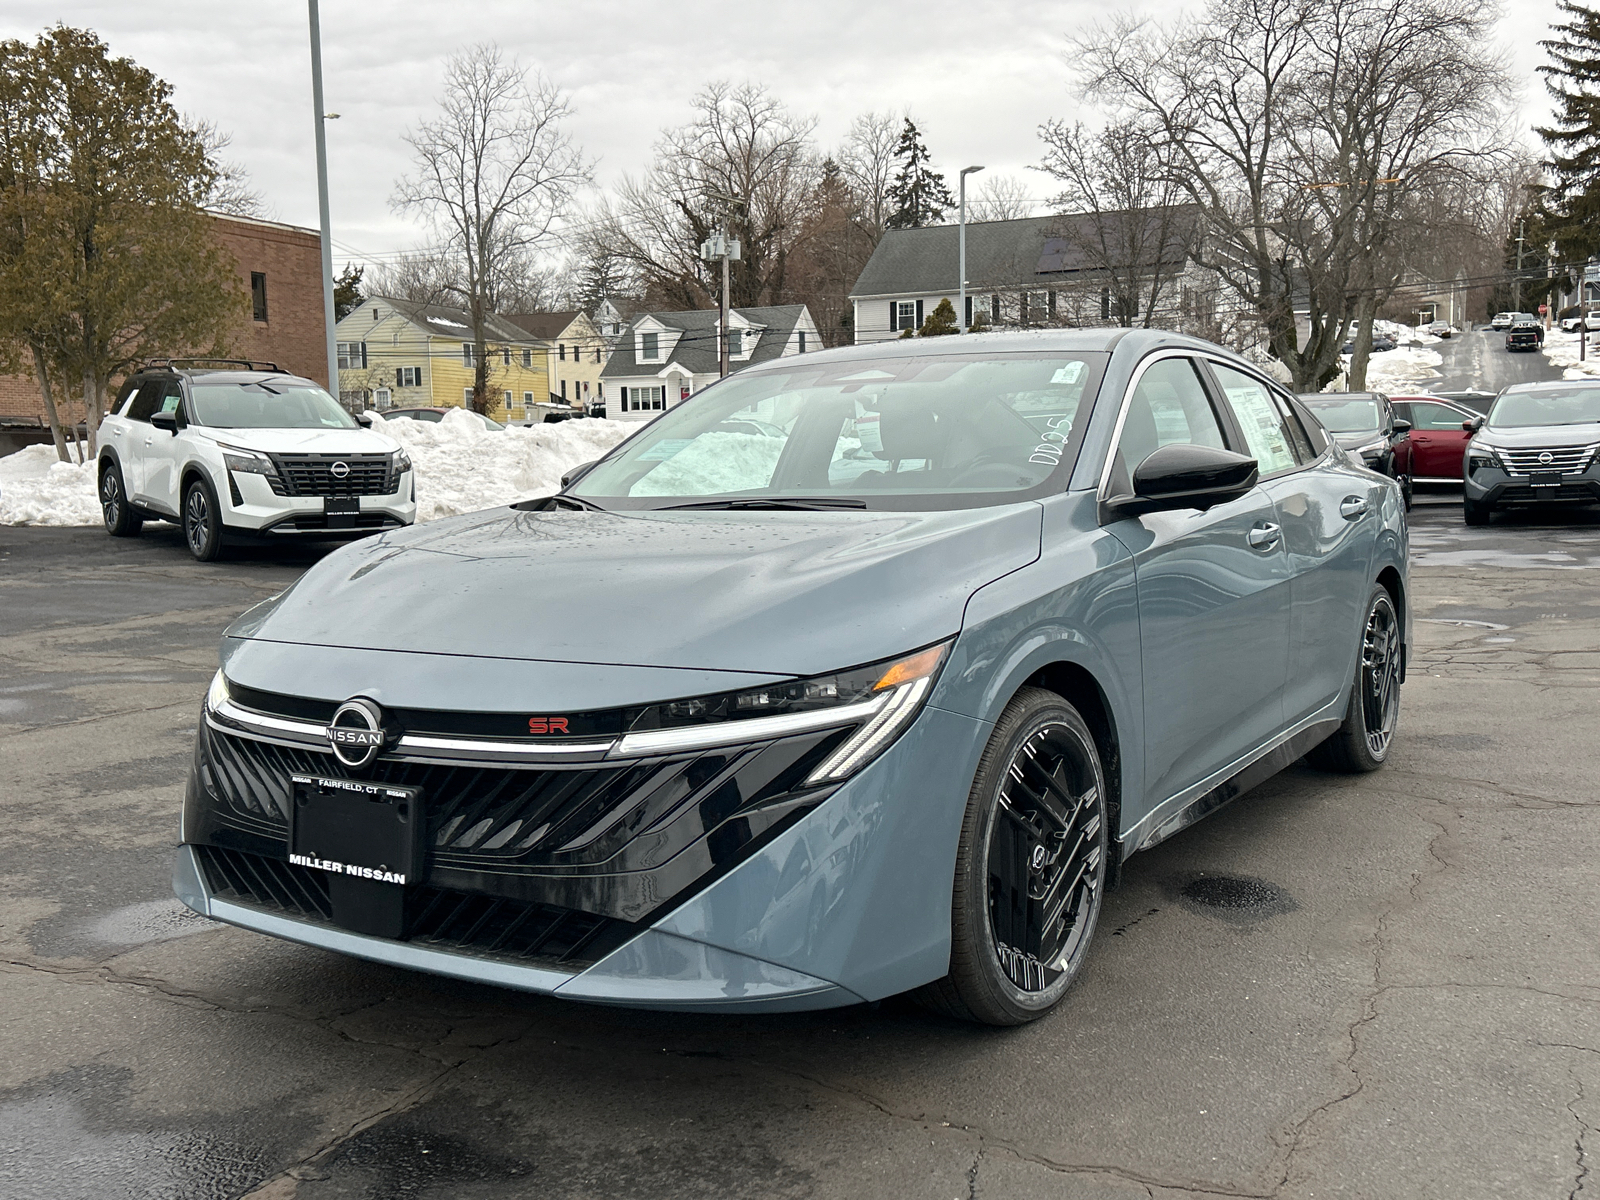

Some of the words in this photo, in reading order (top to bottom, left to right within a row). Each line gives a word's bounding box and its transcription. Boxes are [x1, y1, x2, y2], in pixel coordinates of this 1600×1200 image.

[528, 717, 570, 734] SR
[326, 729, 381, 744] NISSAN
[292, 776, 312, 784] NISSAN
[318, 779, 365, 793] FAIRFIELD,
[365, 786, 379, 795] CT
[386, 789, 407, 799] NISSAN
[289, 853, 343, 873] MILLER
[346, 864, 406, 885] NISSAN
